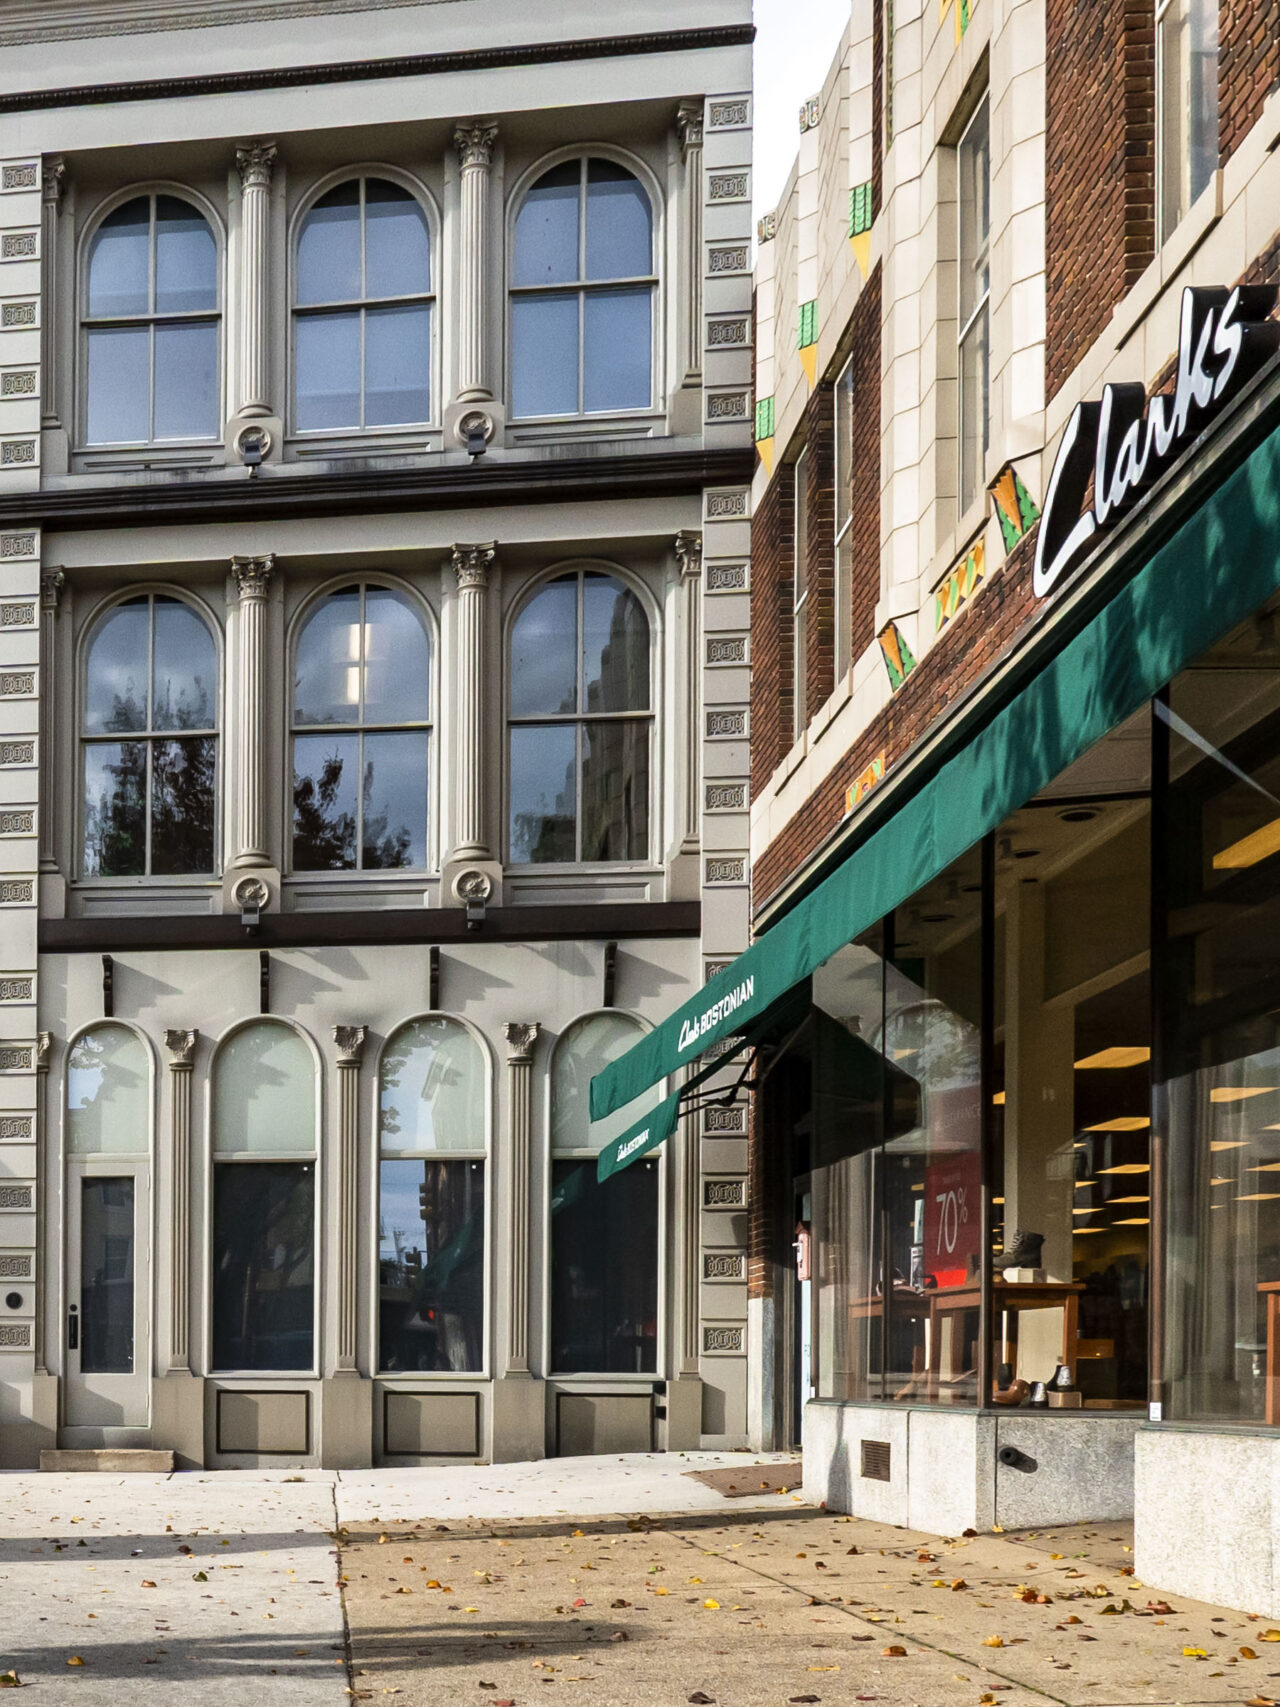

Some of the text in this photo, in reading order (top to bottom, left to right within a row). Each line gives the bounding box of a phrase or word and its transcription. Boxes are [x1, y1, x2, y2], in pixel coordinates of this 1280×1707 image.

[1033, 286, 1243, 598] Clarks
[700, 975, 754, 1035] BOSTONIAN
[935, 1186, 969, 1256] 70%
